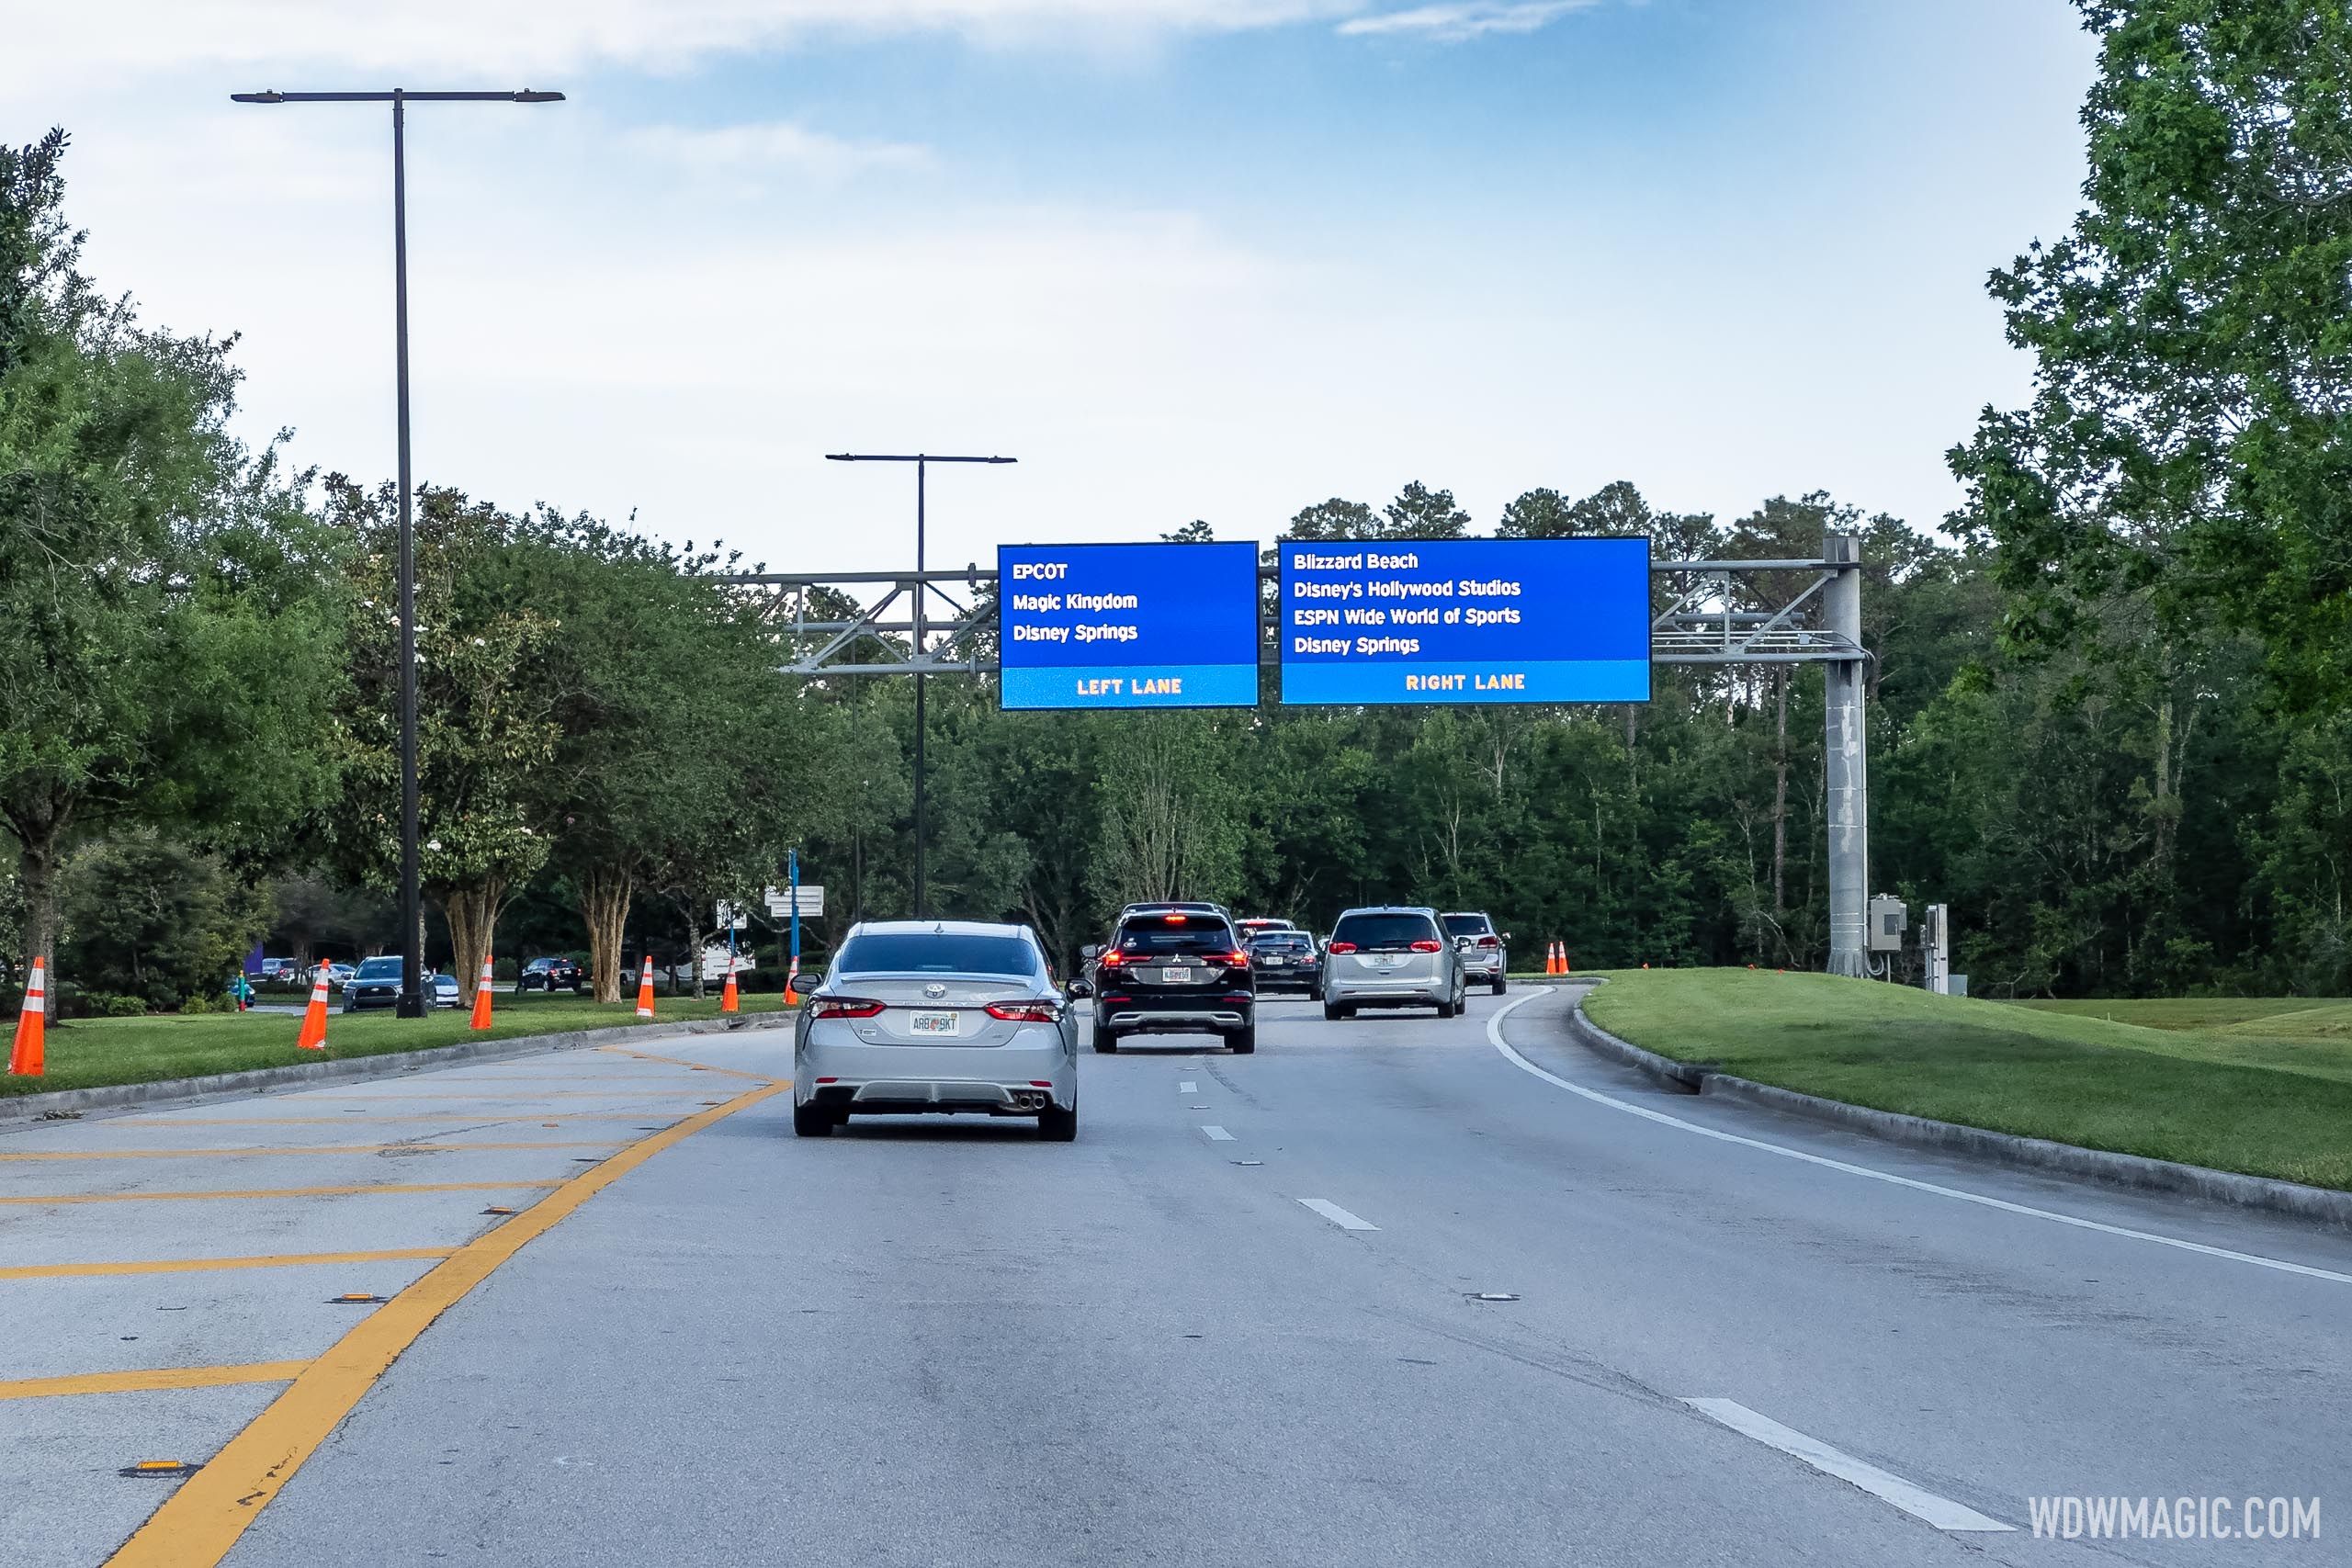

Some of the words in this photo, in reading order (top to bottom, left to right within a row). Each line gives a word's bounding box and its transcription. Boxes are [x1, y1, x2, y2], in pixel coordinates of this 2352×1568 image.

[1295, 553, 1363, 570] Blizzard
[1367, 552, 1419, 569] Beach
[1013, 563, 1068, 580] EPCOT
[1295, 581, 1363, 600] Disney's
[1368, 581, 1453, 600] Hollywood
[1458, 580, 1521, 597] Studios
[1014, 594, 1061, 614] Magic
[1067, 593, 1137, 613] Kingdom
[1295, 609, 1340, 626] ESPN
[1344, 608, 1386, 626] Wide
[1390, 608, 1439, 625] World
[1444, 607, 1461, 625] of
[1464, 607, 1521, 626] Sports
[1014, 625, 1069, 644] Disney
[1075, 624, 1138, 644] Springs
[1295, 637, 1352, 656] Disney
[1356, 637, 1420, 656] Springs
[1077, 680, 1124, 695] LEFT
[1131, 679, 1182, 694] LANE
[1406, 675, 1466, 691] RIGHT
[1475, 674, 1525, 690] LANE
